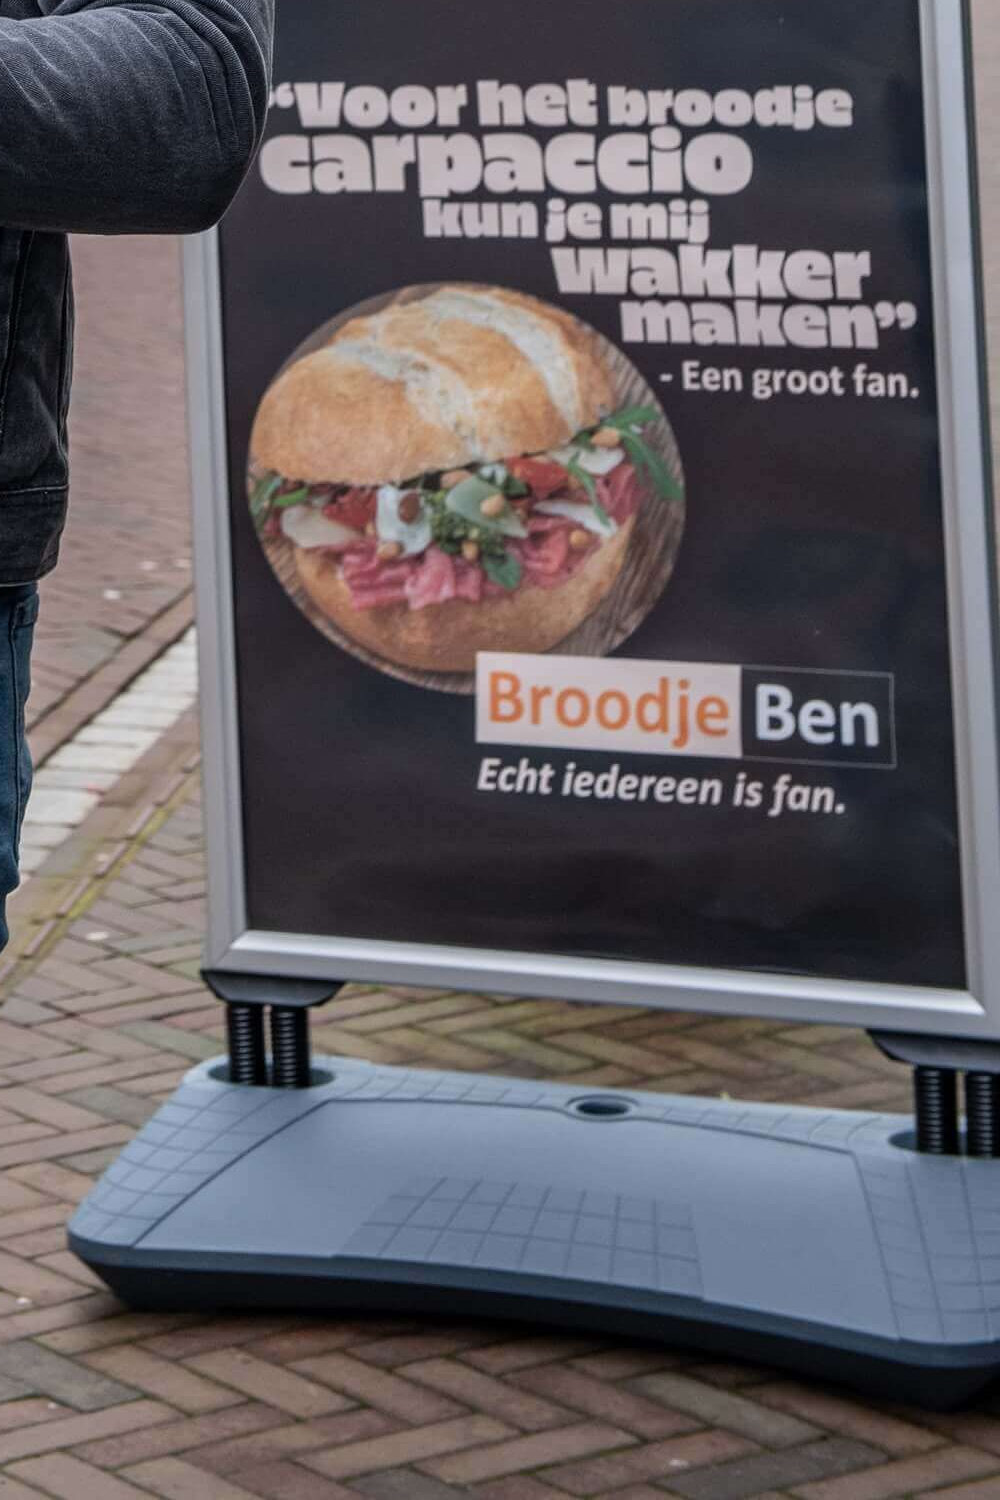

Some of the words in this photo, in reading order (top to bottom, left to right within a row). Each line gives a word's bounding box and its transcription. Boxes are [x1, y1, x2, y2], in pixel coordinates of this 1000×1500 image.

[477, 79, 597, 127] het
[608, 86, 853, 130] broodje
[259, 126, 753, 198] carpaccio
[423, 199, 539, 238] kun
[546, 199, 602, 243] je
[610, 200, 710, 245] mij
[551, 244, 871, 300] wakker
[682, 360, 743, 391] Een
[752, 366, 845, 400] groot
[852, 363, 920, 398] fan.
[488, 671, 729, 749] Broodje
[755, 683, 880, 747] Ben
[477, 757, 555, 795] Echt
[562, 762, 722, 806] iedereen
[733, 772, 763, 807] is
[768, 774, 846, 817] fan.
